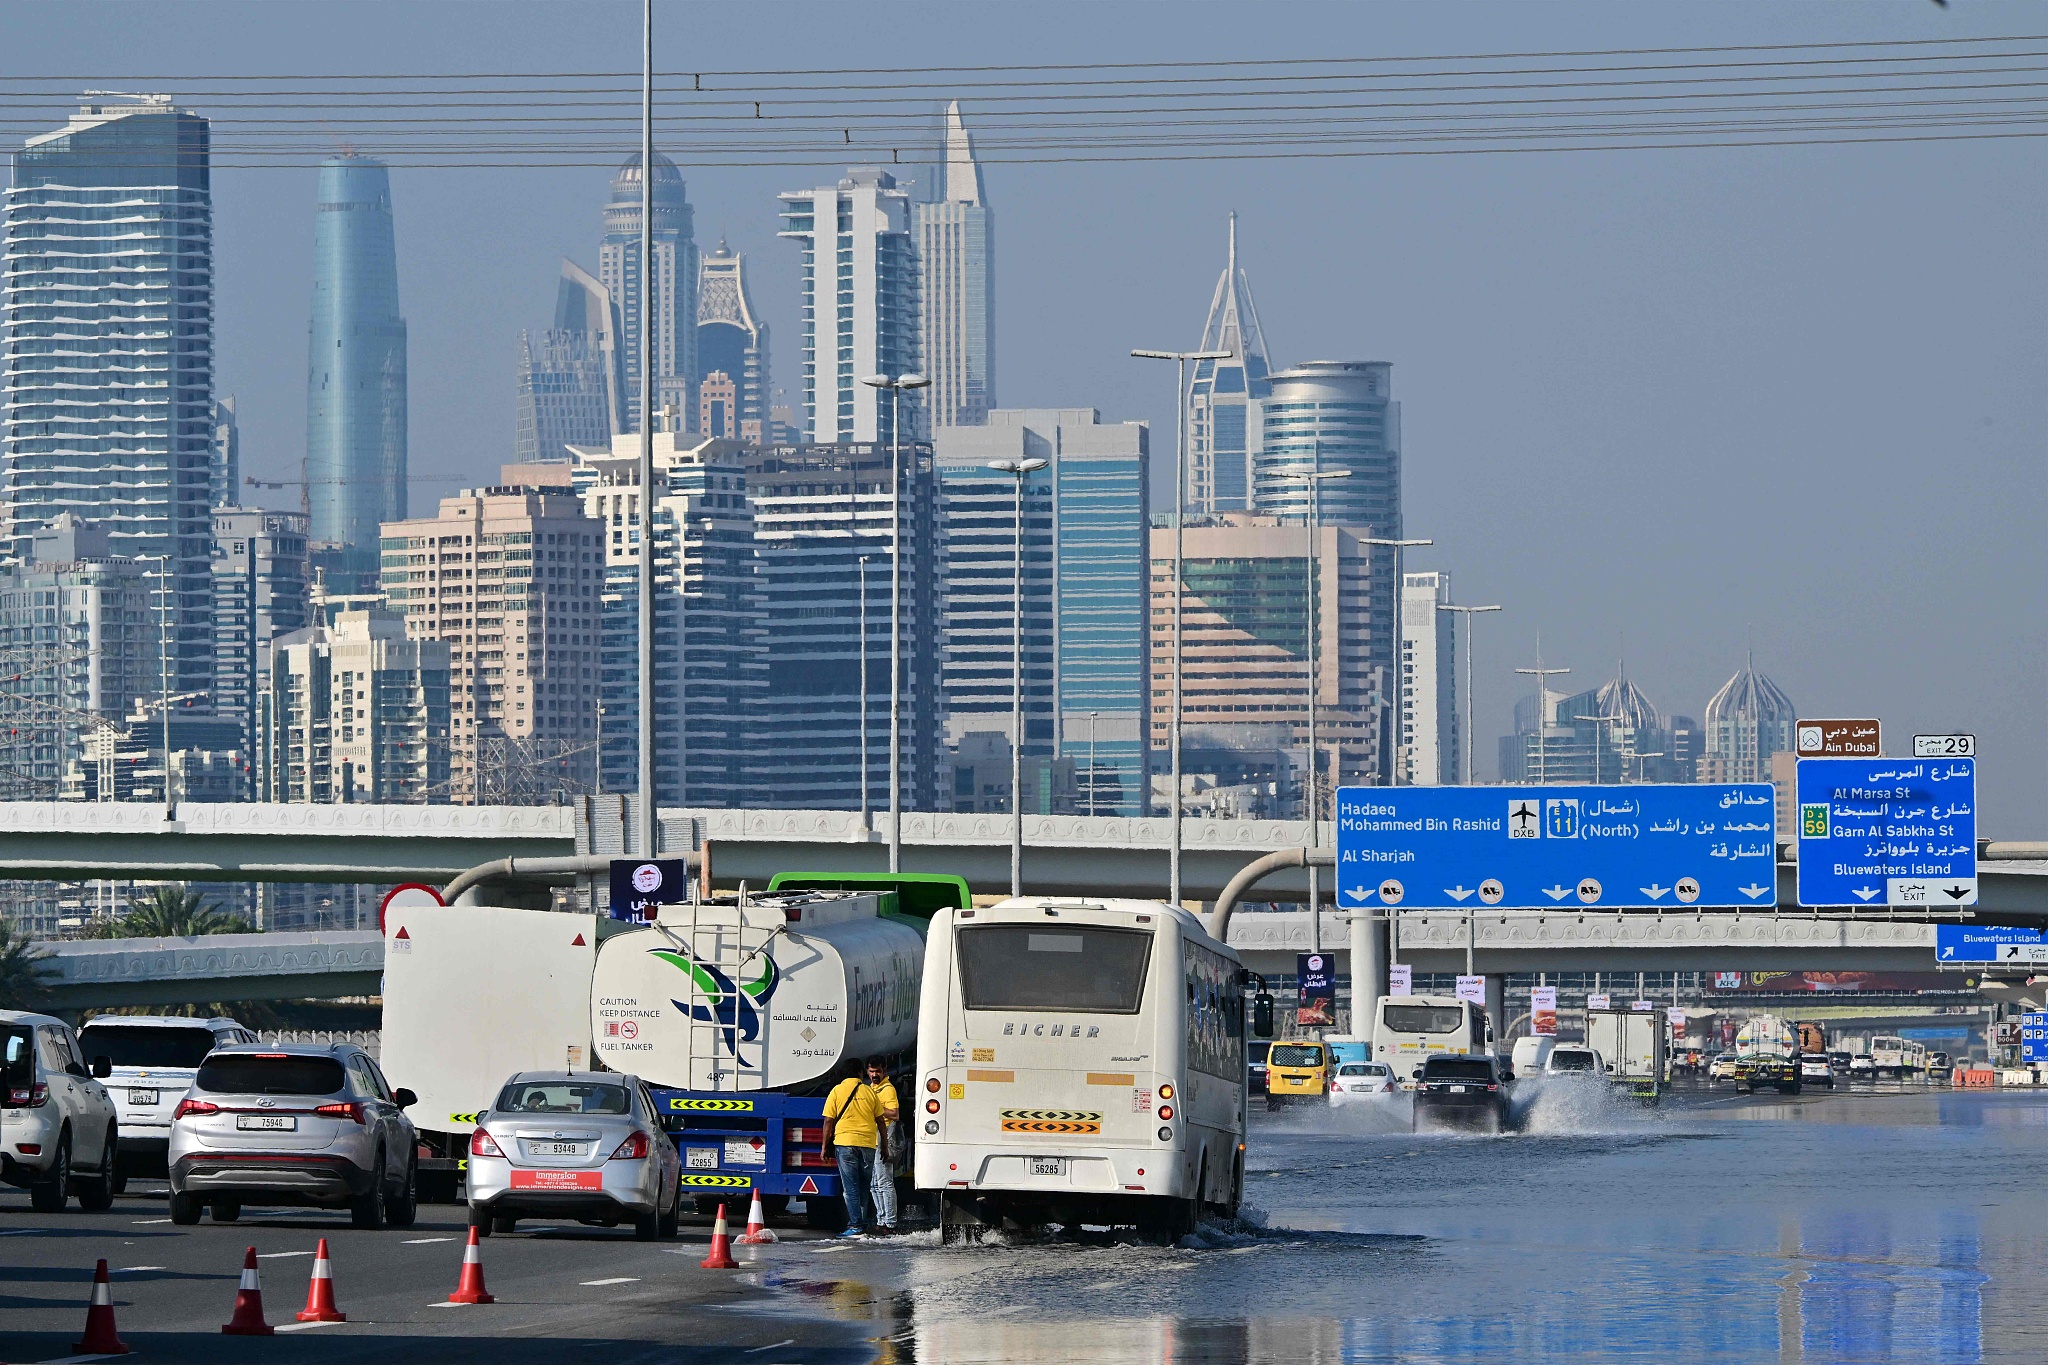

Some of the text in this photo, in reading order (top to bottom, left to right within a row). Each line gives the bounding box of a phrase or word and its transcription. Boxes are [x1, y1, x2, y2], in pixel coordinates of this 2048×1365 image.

[1825, 726, 1876, 741] عين دبي
[1825, 742, 1876, 752] Ain Dubai
[1918, 739, 1941, 748] مخرج
[1944, 737, 1969, 753] 29
[1868, 764, 1970, 782] شارع المرسى
[1833, 787, 1911, 799] Al Marsa St
[1719, 789, 1770, 809] حدائق
[1341, 802, 1396, 817] Hadaeq
[1554, 807, 1560, 816] E
[1807, 810, 1814, 818] D
[1833, 803, 1971, 820] شارع جرن السبخة
[1341, 817, 1500, 831] Mohammed Bin Rashid
[1554, 817, 1571, 833] 11
[1649, 817, 1771, 835] محمد بن راشد
[1805, 820, 1826, 834] 59
[1513, 829, 1535, 838] DXB
[1581, 823, 1639, 841] (North)
[1833, 825, 1954, 837] Garn Al Sabkha St
[1709, 842, 1771, 861] الشارقة
[1863, 841, 1971, 857] جزيرة بلوواترز
[1341, 849, 1415, 863] Al Sharjah
[1833, 863, 1951, 875] Bluewaters Island
[1899, 884, 1925, 892] مخرج
[1903, 892, 1926, 901] EXIT
[1963, 934, 2041, 942] Bluewaters Island
[393, 941, 410, 949] STS
[599, 998, 637, 1006] CAUTION
[853, 965, 886, 1031] Emarat
[806, 1004, 838, 1012] انتبه
[599, 1009, 660, 1018] KEEP DISTANCE
[803, 1014, 818, 1022] على
[819, 1015, 837, 1023] حافظ
[1002, 1022, 1100, 1038] EICHER
[600, 1042, 654, 1051] FUEL TANKER
[792, 1048, 835, 1058] ناقلة وقود
[706, 1072, 725, 1082] 489
[553, 1144, 576, 1153] 93449
[690, 1158, 712, 1167] 42855
[1035, 1164, 1058, 1174] 56285
